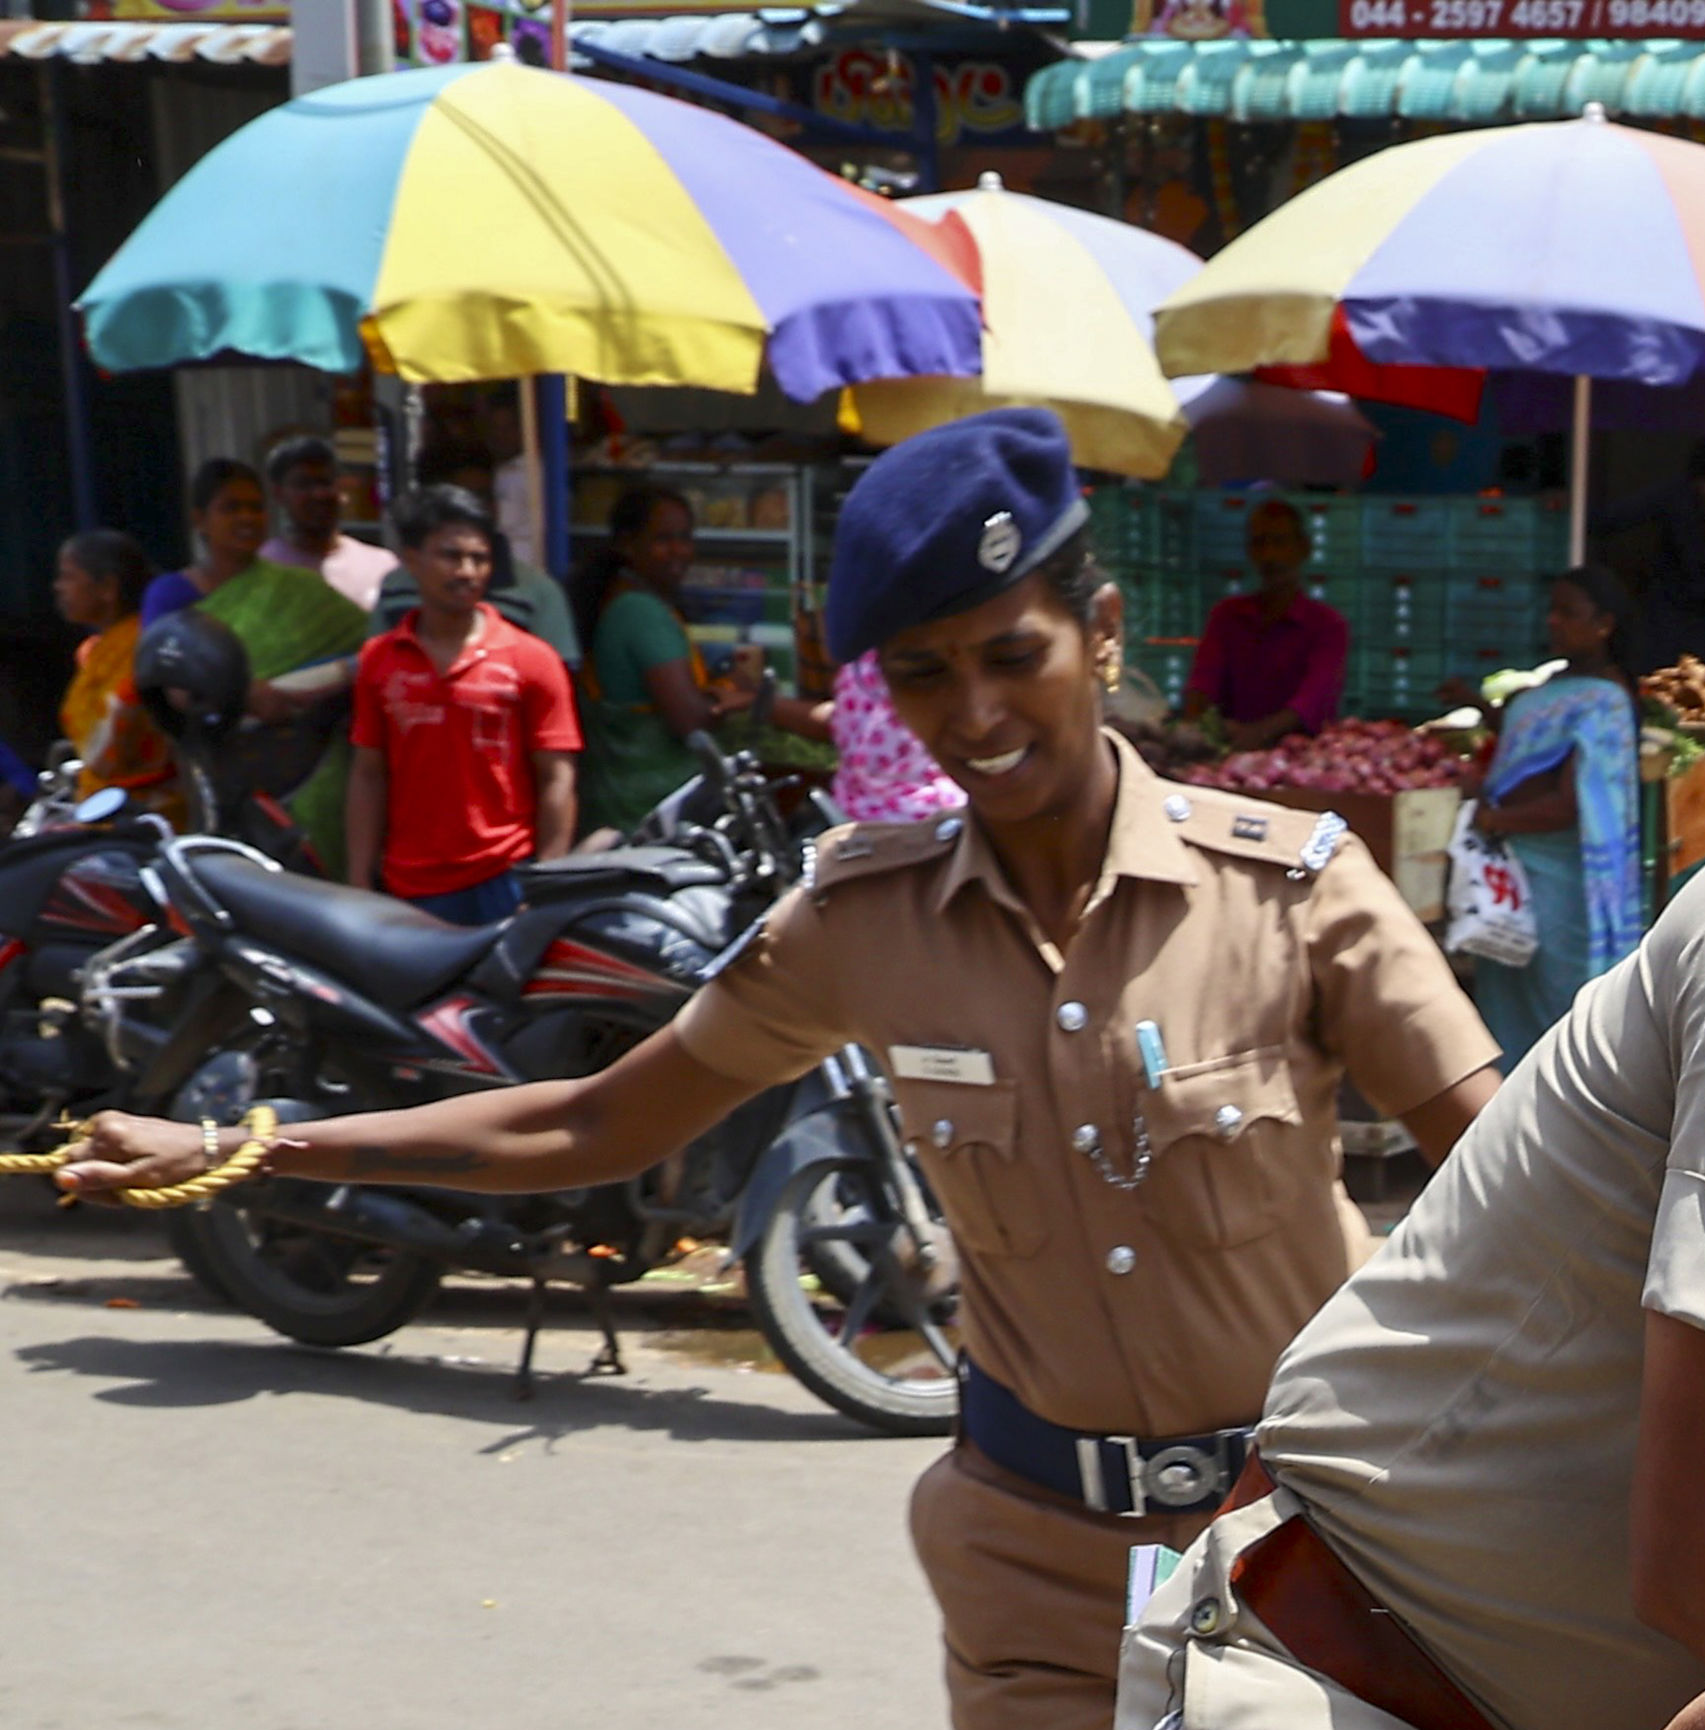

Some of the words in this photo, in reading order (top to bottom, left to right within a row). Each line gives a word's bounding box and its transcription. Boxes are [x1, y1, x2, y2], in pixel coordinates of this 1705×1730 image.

[1350, 0, 1406, 28] 044
[1429, 0, 1505, 28] 2597
[1510, 0, 1584, 29] 4657
